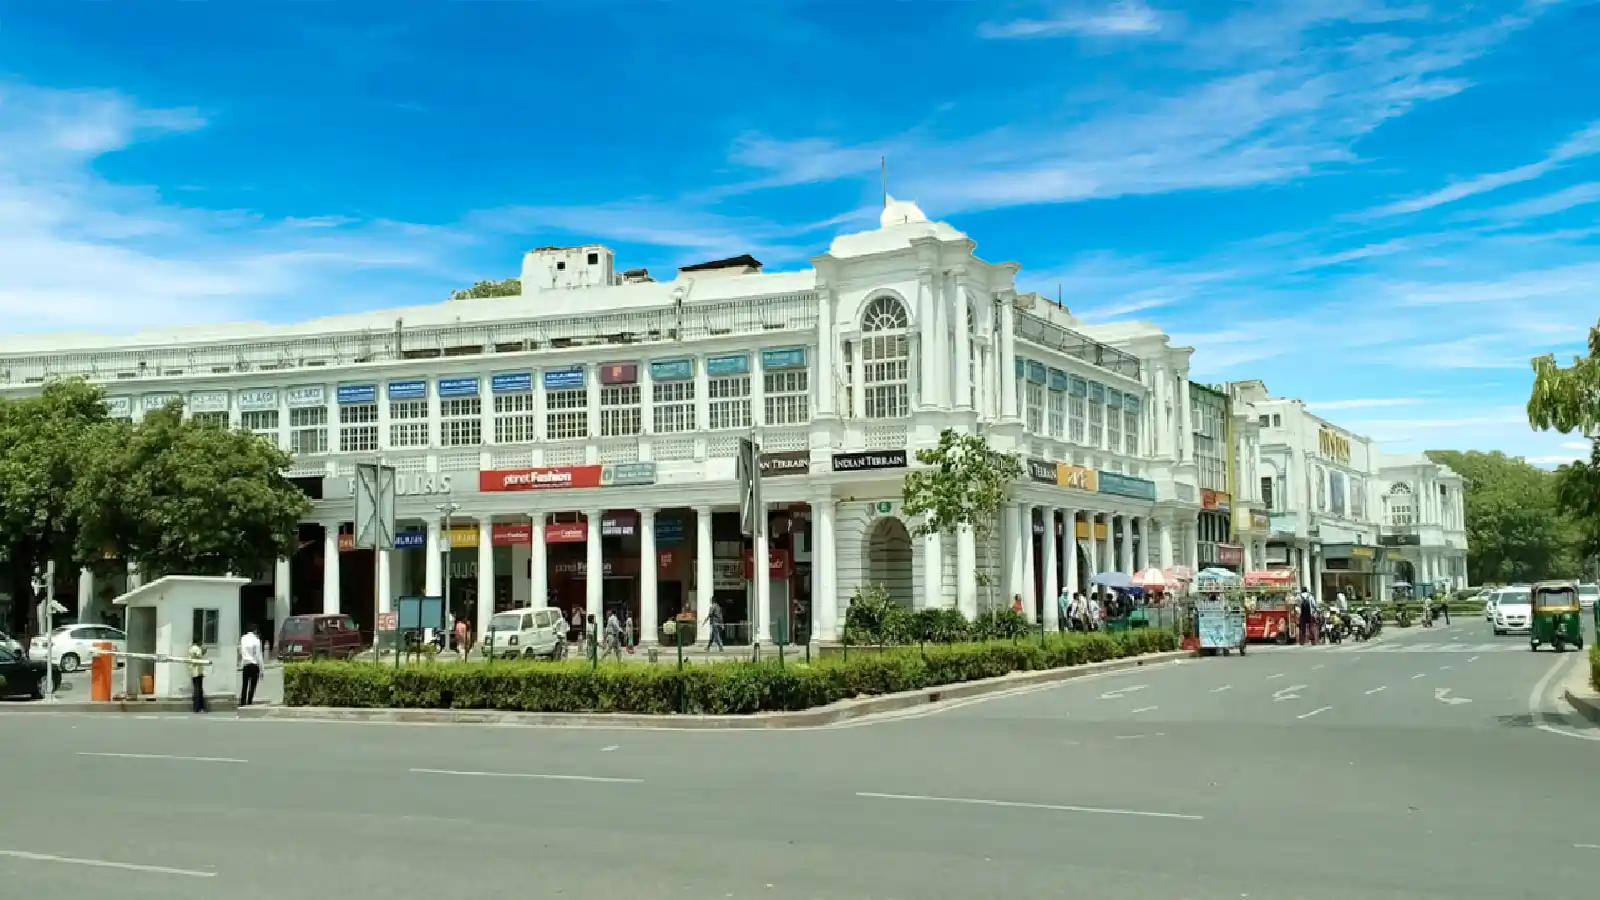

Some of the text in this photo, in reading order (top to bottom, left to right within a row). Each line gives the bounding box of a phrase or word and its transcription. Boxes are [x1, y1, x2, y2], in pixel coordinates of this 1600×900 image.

[772, 458, 809, 469] TERRAIN
[865, 455, 903, 466] TERRAIN
[530, 470, 572, 483] Fashion
